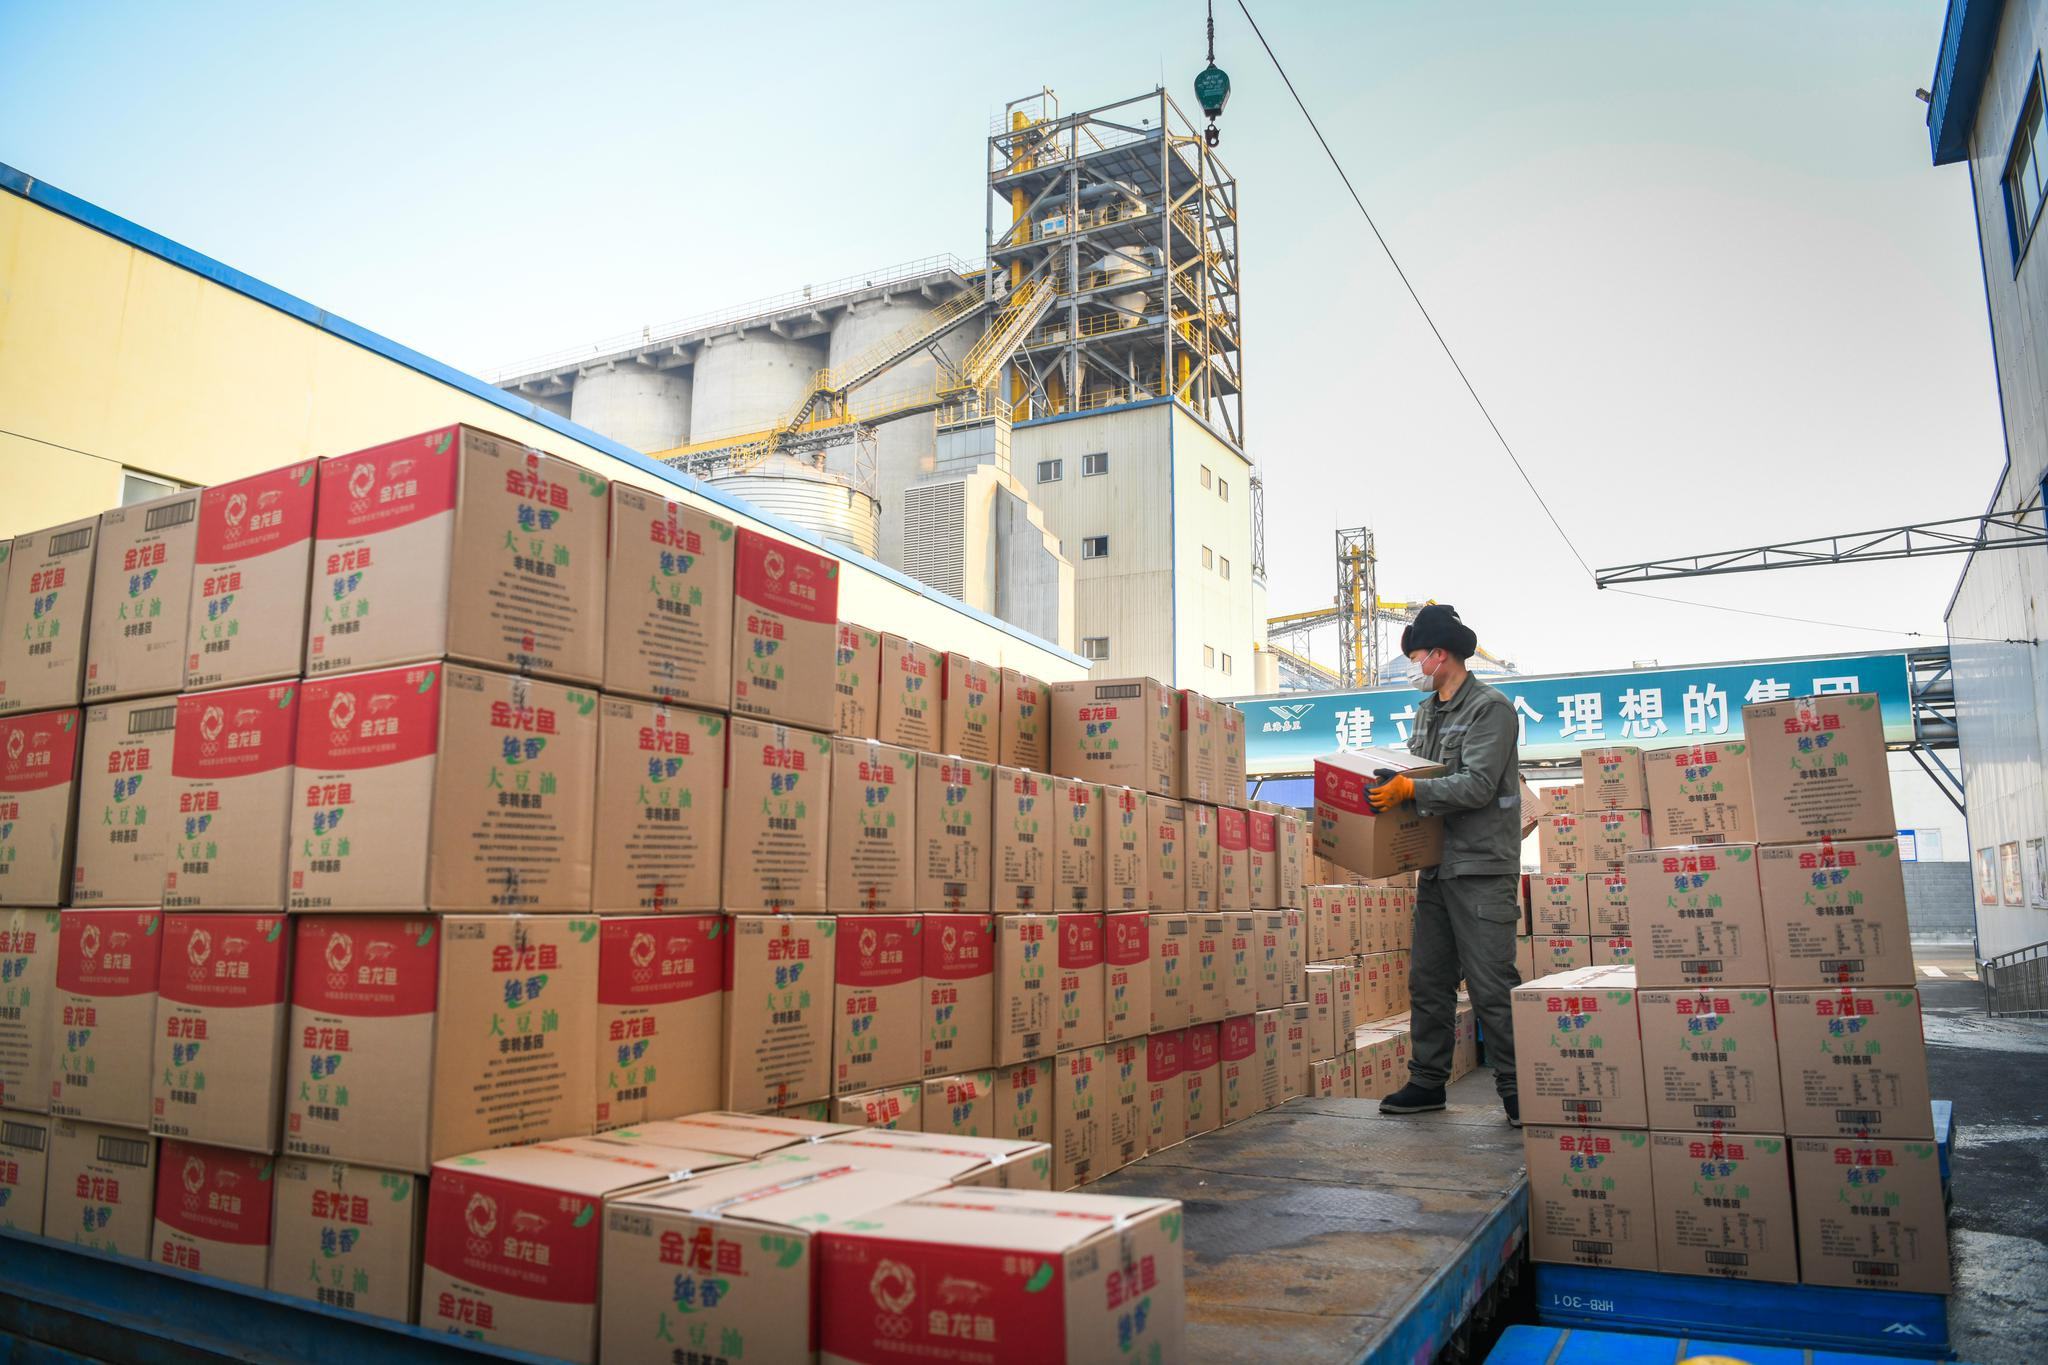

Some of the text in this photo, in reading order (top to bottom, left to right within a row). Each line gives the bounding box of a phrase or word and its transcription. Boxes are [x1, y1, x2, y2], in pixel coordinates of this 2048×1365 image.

[380, 480, 417, 503] 金龙鱼
[506, 469, 568, 507] 金龙鱼
[250, 510, 283, 530] 金龙鱼
[518, 505, 553, 530] 纯香
[651, 520, 701, 555] 金龙鱼
[124, 542, 166, 571] 金龙鱼
[504, 530, 569, 567] 大豆油
[327, 548, 371, 575] 金龙鱼
[514, 556, 555, 578] 非转基因
[30, 568, 65, 593] 金龙鱼
[203, 571, 241, 597] 金龙鱼
[648, 576, 702, 606] 大豆油
[118, 600, 161, 621] 大豆油
[323, 600, 368, 622] 大豆油
[748, 615, 783, 640] 金龙鱼
[746, 657, 784, 680] 大豆油
[491, 700, 556, 735] 金龙鱼
[1079, 707, 1117, 721] 金龙鱼
[1335, 676, 1860, 753] 建立个理想的
[1784, 713, 1840, 734] 金龙鱼
[361, 718, 399, 737] 金龙鱼
[228, 730, 261, 748] 金龙鱼
[503, 737, 538, 760] 纯香
[639, 727, 690, 755] 金龙鱼
[1797, 735, 1828, 749] 纯香
[108, 748, 151, 773] 金龙鱼
[763, 745, 805, 771] 金龙鱼
[1675, 752, 1718, 766] 金龙鱼
[1789, 753, 1848, 770] 大豆油
[487, 767, 556, 795] 大豆油
[1800, 768, 1837, 779] 非转基因
[307, 783, 352, 807] 金龙鱼
[636, 785, 693, 808] 大豆油
[1679, 782, 1724, 794] 大豆油
[1688, 792, 1717, 802] 非转基因
[180, 791, 220, 812] 金龙鱼
[498, 792, 541, 808] 非转基因
[761, 797, 806, 818] 大豆油
[103, 805, 146, 825] 大豆油
[645, 808, 680, 822] 非转基因
[176, 840, 217, 859] 大豆油
[303, 837, 350, 857] 大豆油
[1662, 856, 1716, 873] 金龙鱼
[1799, 850, 1857, 868] 金龙鱼
[1675, 875, 1704, 889] 纯香
[1812, 870, 1842, 885] 纯香
[1666, 894, 1723, 908] 大豆油
[1803, 891, 1863, 905] 大豆油
[1678, 908, 1714, 918] 非转基因
[1816, 906, 1854, 916] 非转基因
[492, 943, 558, 972] 金龙鱼
[768, 938, 811, 961] 金龙鱼
[103, 953, 132, 969] 金龙鱼
[215, 960, 249, 978] 金龙鱼
[661, 958, 695, 977] 金龙鱼
[357, 966, 398, 985] 金龙鱼
[504, 978, 541, 1002] 纯香
[766, 991, 811, 1011] 大豆油
[1547, 997, 1598, 1013] 金龙鱼
[1676, 998, 1731, 1015] 金龙鱼
[1816, 998, 1875, 1016] 金龙鱼
[63, 1006, 96, 1026] 金龙鱼
[488, 1008, 558, 1037] 大豆油
[1557, 1016, 1586, 1031] 纯香
[1688, 1017, 1719, 1032] 纯香
[1829, 1018, 1861, 1034] 纯香
[167, 1017, 208, 1040] 金龙鱼
[609, 1016, 656, 1042] 金龙鱼
[303, 1027, 350, 1052] 金龙鱼
[500, 1034, 544, 1054] 非转基因
[1548, 1034, 1603, 1049] 大豆油
[1679, 1037, 1737, 1052] 大豆油
[1819, 1039, 1881, 1054] 大豆油
[1560, 1049, 1595, 1059] 非转基因
[1691, 1052, 1728, 1062] 非转基因
[1832, 1054, 1871, 1065] 非转基因
[162, 1068, 205, 1091] 大豆油
[608, 1066, 657, 1088] 大豆油
[299, 1081, 349, 1106] 大豆油
[1560, 1136, 1611, 1153] 金龙鱼
[1689, 1142, 1745, 1160] 金龙鱼
[1570, 1155, 1599, 1169] 纯香
[1834, 1149, 1893, 1165] 金龙鱼
[1701, 1162, 1731, 1176] 纯香
[1848, 1169, 1879, 1183] 纯香
[76, 1174, 119, 1204] 金龙鱼
[1561, 1174, 1615, 1190] 大豆油
[1692, 1181, 1750, 1198] 大豆油
[1572, 1189, 1607, 1200] 非转基因
[1704, 1198, 1740, 1208] 非转基因
[1839, 1189, 1899, 1206] 大豆油
[312, 1190, 369, 1224] 金龙鱼
[1851, 1205, 1890, 1217] 非转基因
[162, 1241, 200, 1269] 金龙鱼
[504, 1238, 551, 1265] 金龙鱼
[660, 1231, 742, 1275] 金龙鱼
[309, 1260, 368, 1293] 大豆油
[673, 1274, 721, 1306] 纯香
[438, 1292, 493, 1328] 金龙鱼
[1554, 1294, 1614, 1312] HRB-301
[929, 1311, 996, 1342] 金龙鱼
